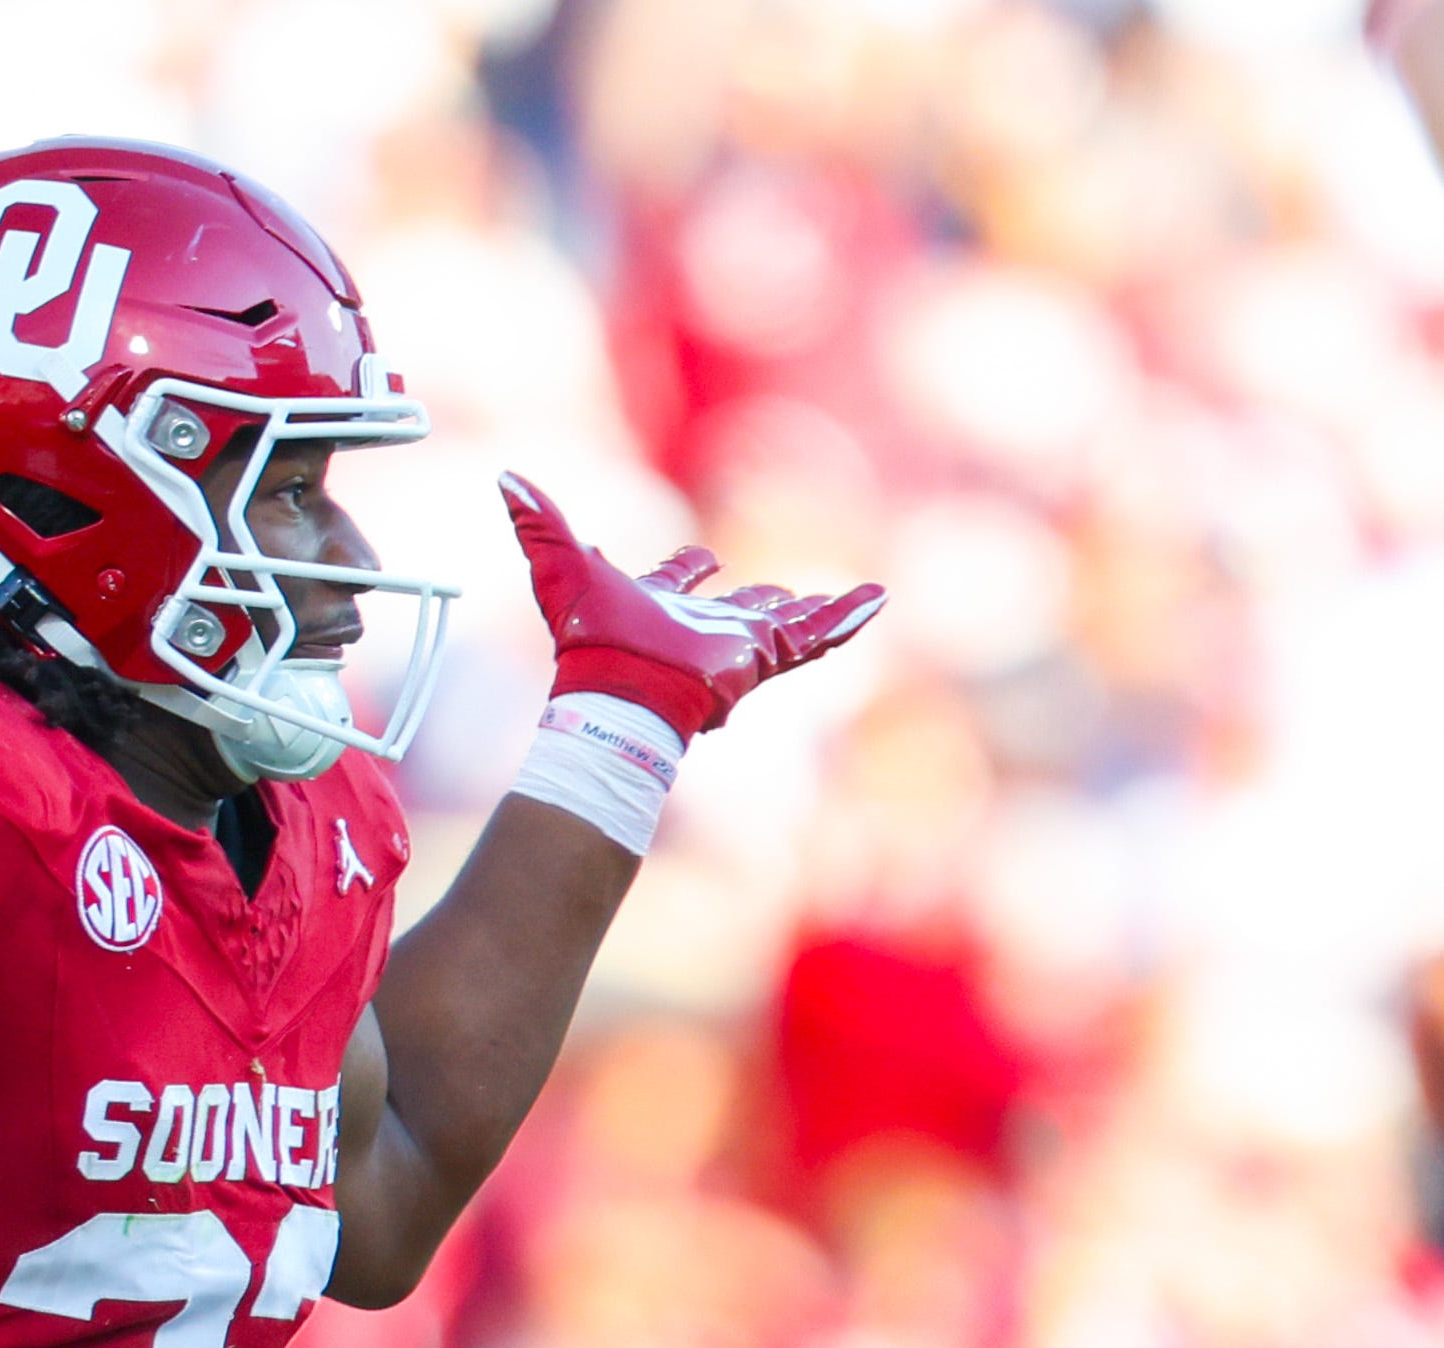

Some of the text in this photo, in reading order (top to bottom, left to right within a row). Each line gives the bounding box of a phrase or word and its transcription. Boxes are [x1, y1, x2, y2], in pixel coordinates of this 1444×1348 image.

[581, 721, 650, 762] Matthew
[84, 834, 158, 942] SEC
[76, 1079, 341, 1189] SOONER
